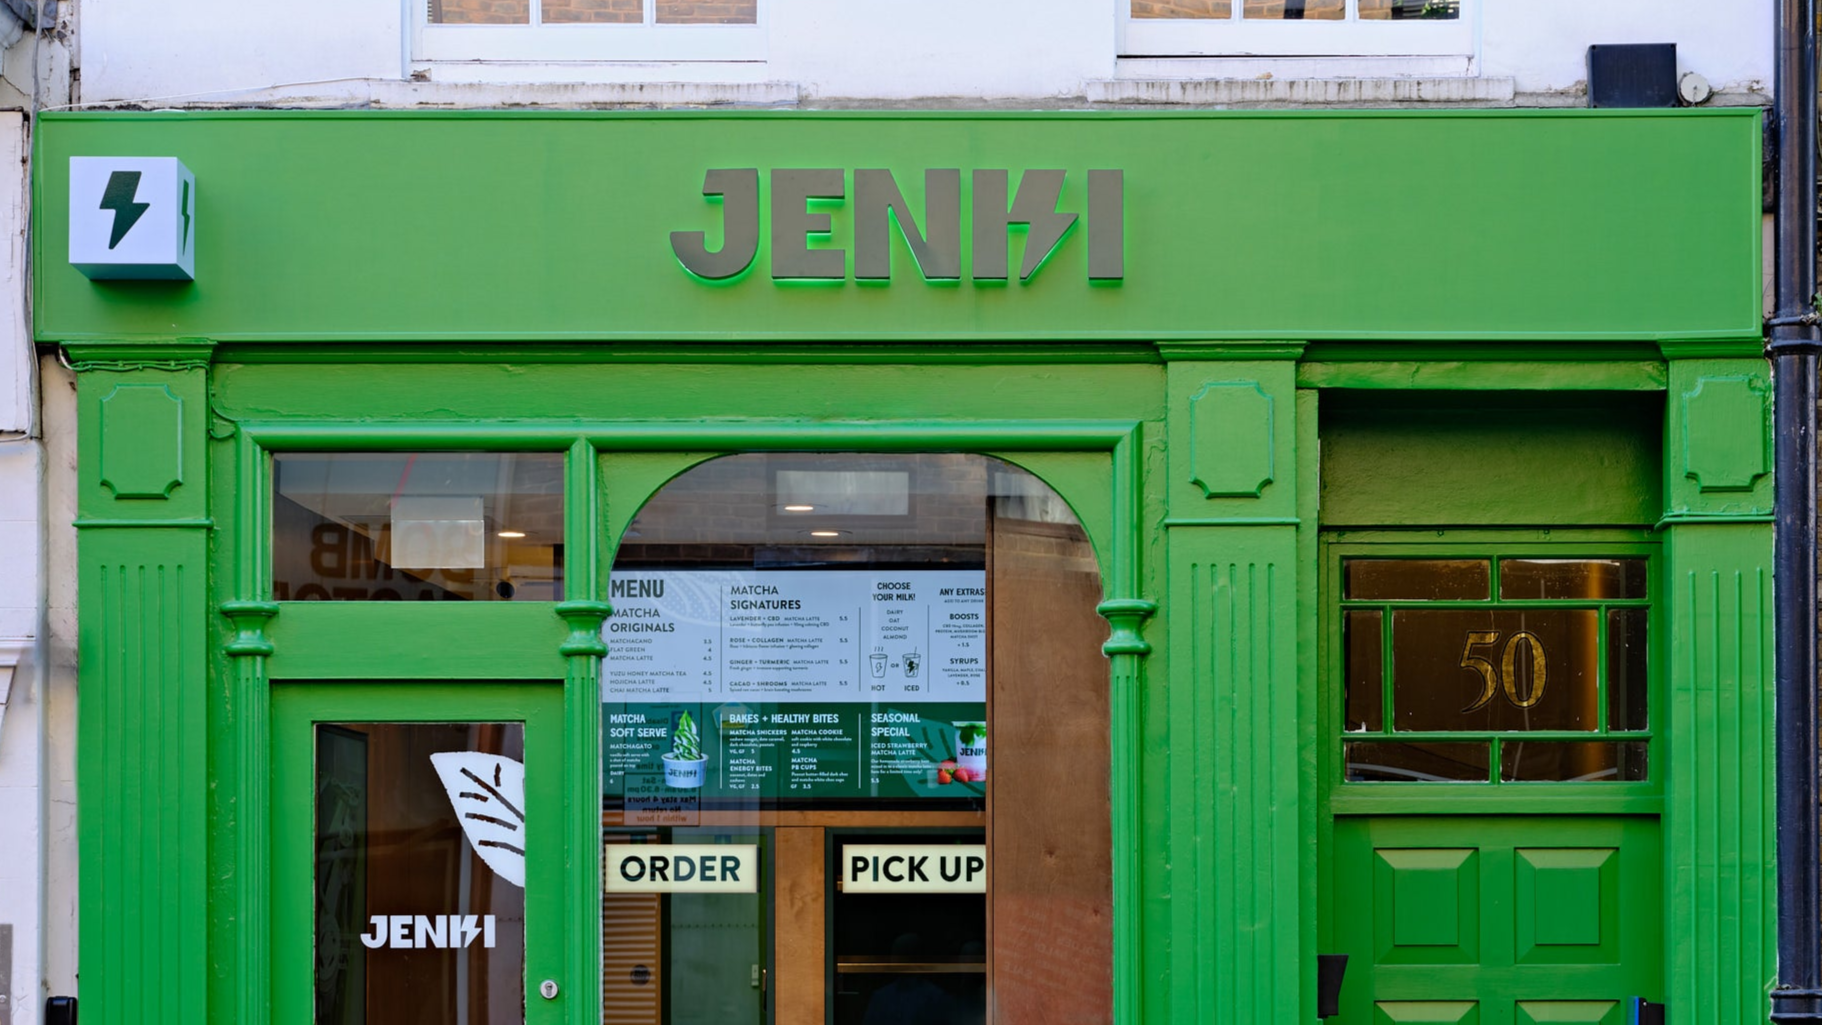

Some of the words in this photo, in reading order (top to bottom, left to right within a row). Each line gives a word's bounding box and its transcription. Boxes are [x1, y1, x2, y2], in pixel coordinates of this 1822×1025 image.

[670, 168, 1124, 280] JENKI
[611, 579, 664, 598] MENU
[730, 586, 778, 595] MATCHA
[730, 600, 801, 610] SIGNATURES
[612, 608, 660, 618] MATCHA
[610, 622, 674, 632] ORIGINALS
[1458, 630, 1548, 714] 50
[610, 714, 646, 724] MATCHA
[730, 714, 759, 724] BAKES
[771, 714, 810, 724] HEALTHY
[813, 714, 839, 724] BITES
[871, 713, 920, 722] SEASONAL
[610, 728, 634, 737] SOFT
[638, 728, 668, 737] SERVE
[871, 727, 910, 736] SPECIAL
[668, 768, 697, 778] JENKI
[620, 856, 740, 882] ORDER
[852, 856, 929, 882] PICK
[940, 856, 984, 882] UP
[360, 914, 496, 948] JENKI
